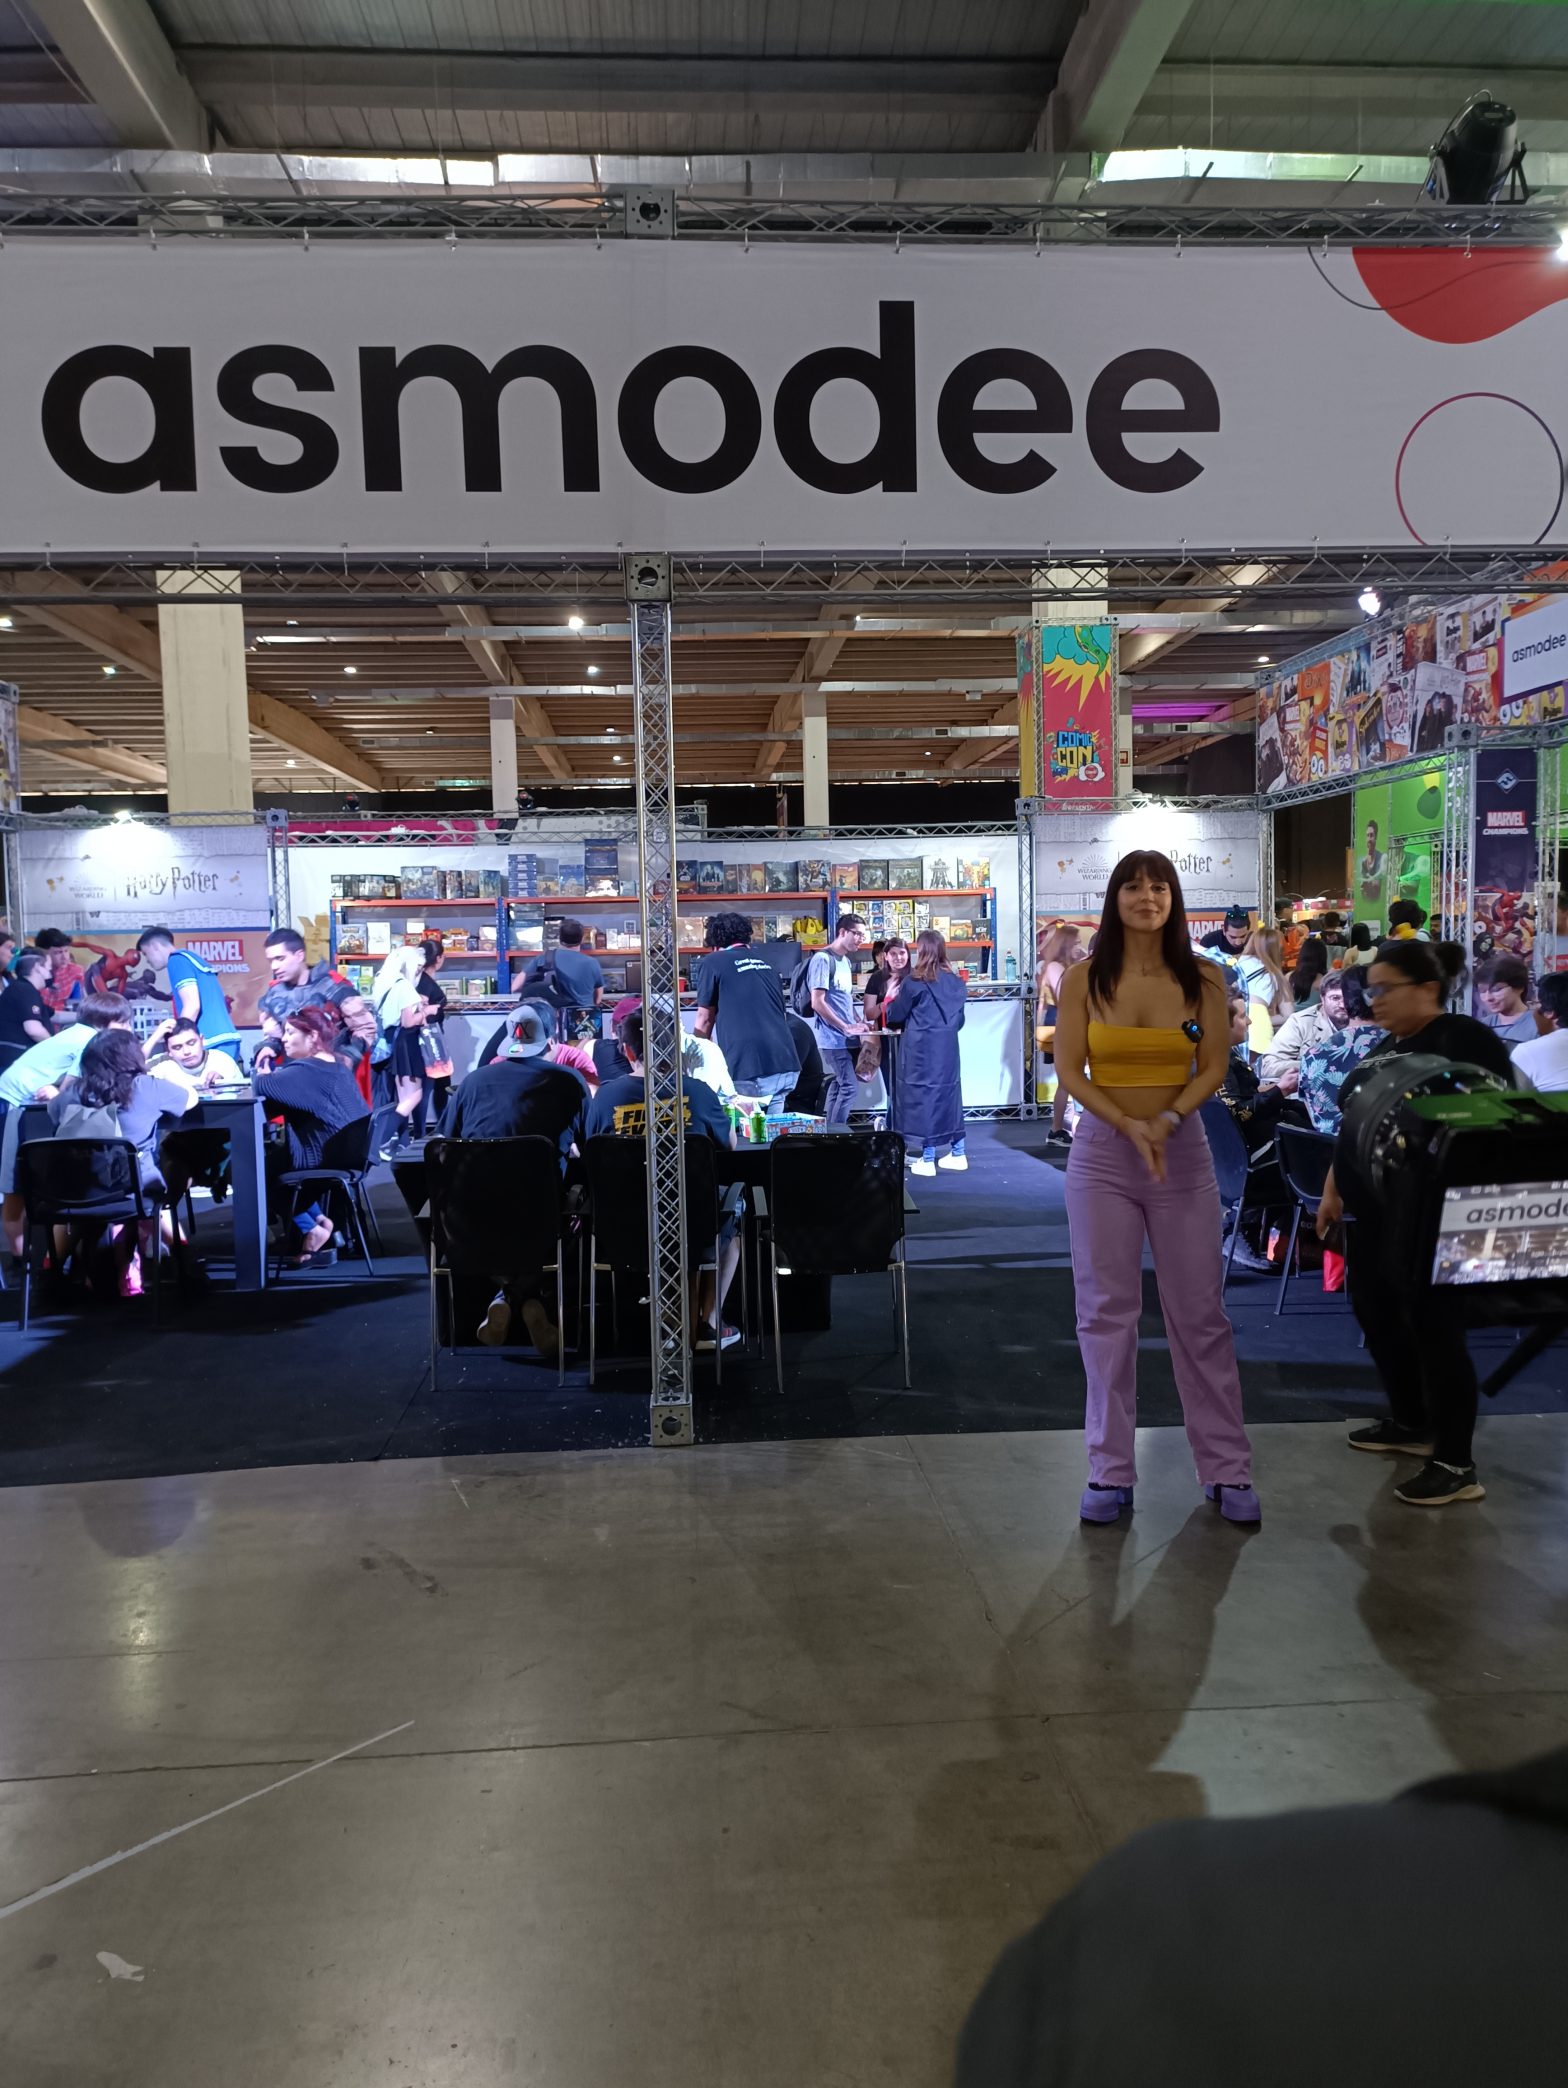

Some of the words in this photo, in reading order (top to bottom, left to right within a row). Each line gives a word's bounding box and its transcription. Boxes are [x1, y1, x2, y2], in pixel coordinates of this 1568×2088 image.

[40, 301, 1221, 495] asmodee
[1512, 633, 1567, 663] asmodee
[1057, 731, 1093, 747] COMIC
[1057, 745, 1093, 768] CON
[1487, 811, 1525, 827] MARVEL
[171, 866, 219, 899] Potter
[187, 940, 243, 961] MARVEL
